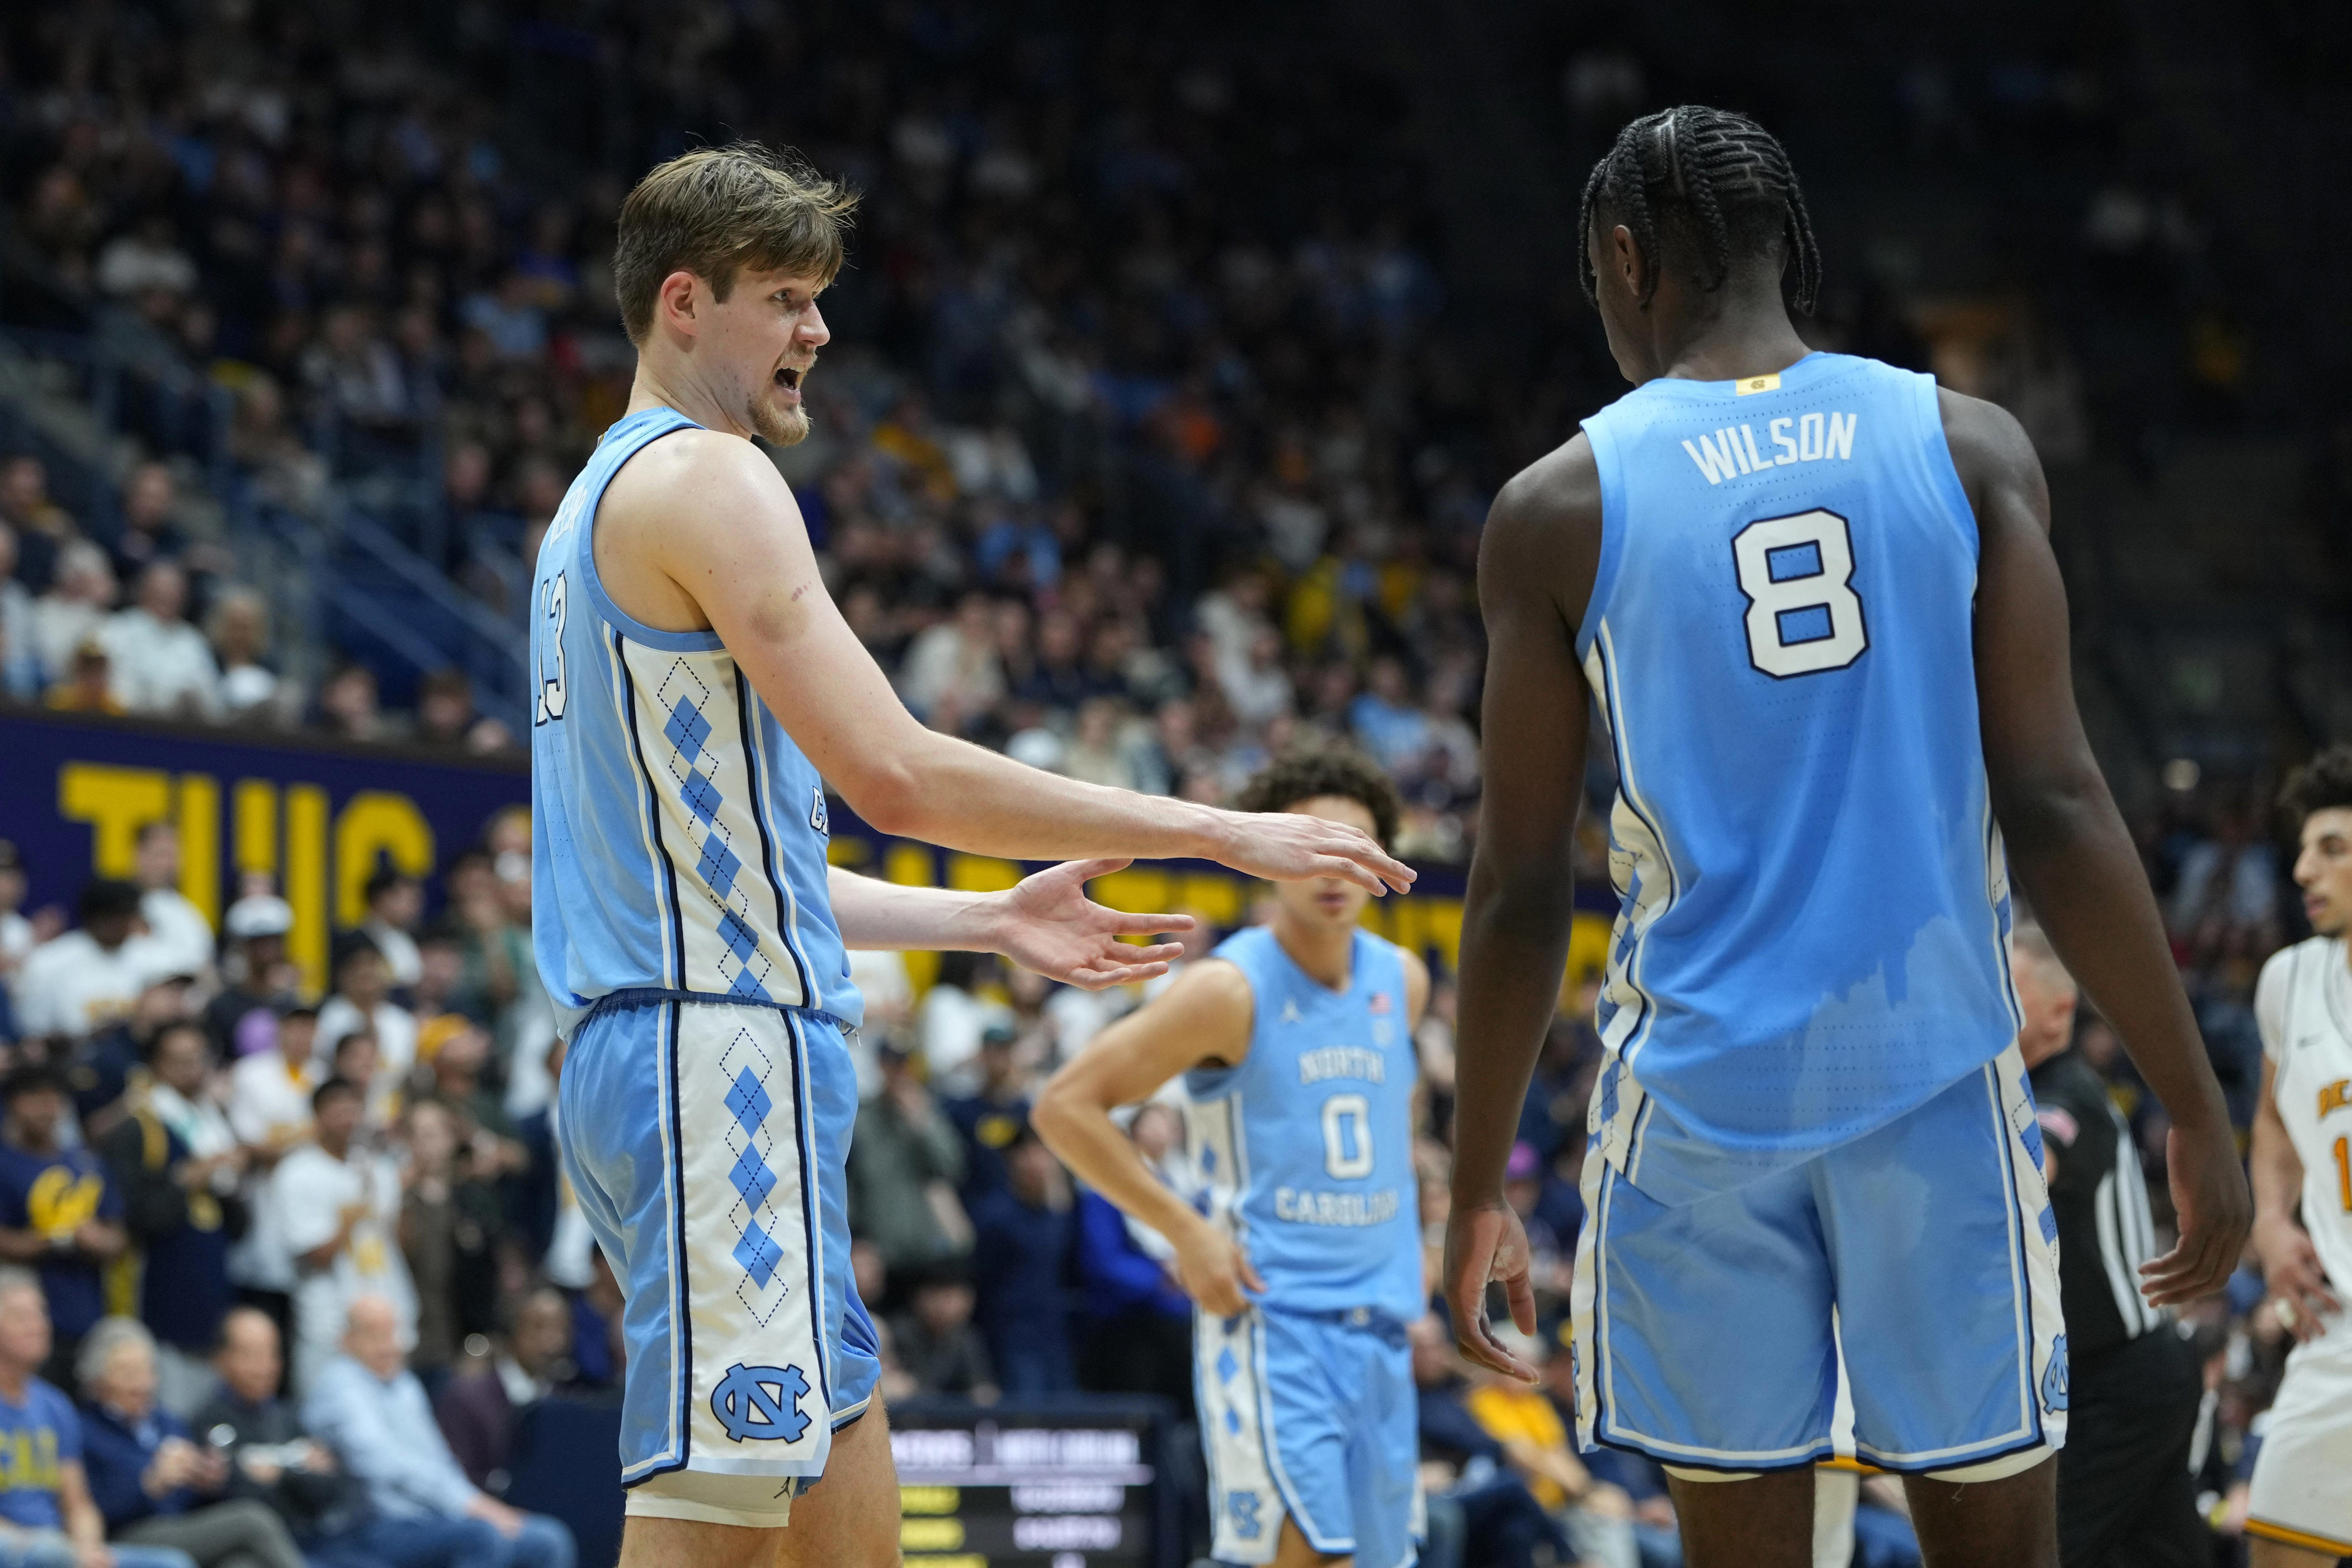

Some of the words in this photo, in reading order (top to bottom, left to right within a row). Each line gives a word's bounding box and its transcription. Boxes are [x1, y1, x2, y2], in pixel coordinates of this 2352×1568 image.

[1682, 412, 1857, 485] WILSON
[535, 569, 567, 727] 13
[1731, 506, 1871, 681] 8
[1321, 1093, 1376, 1181] 0
